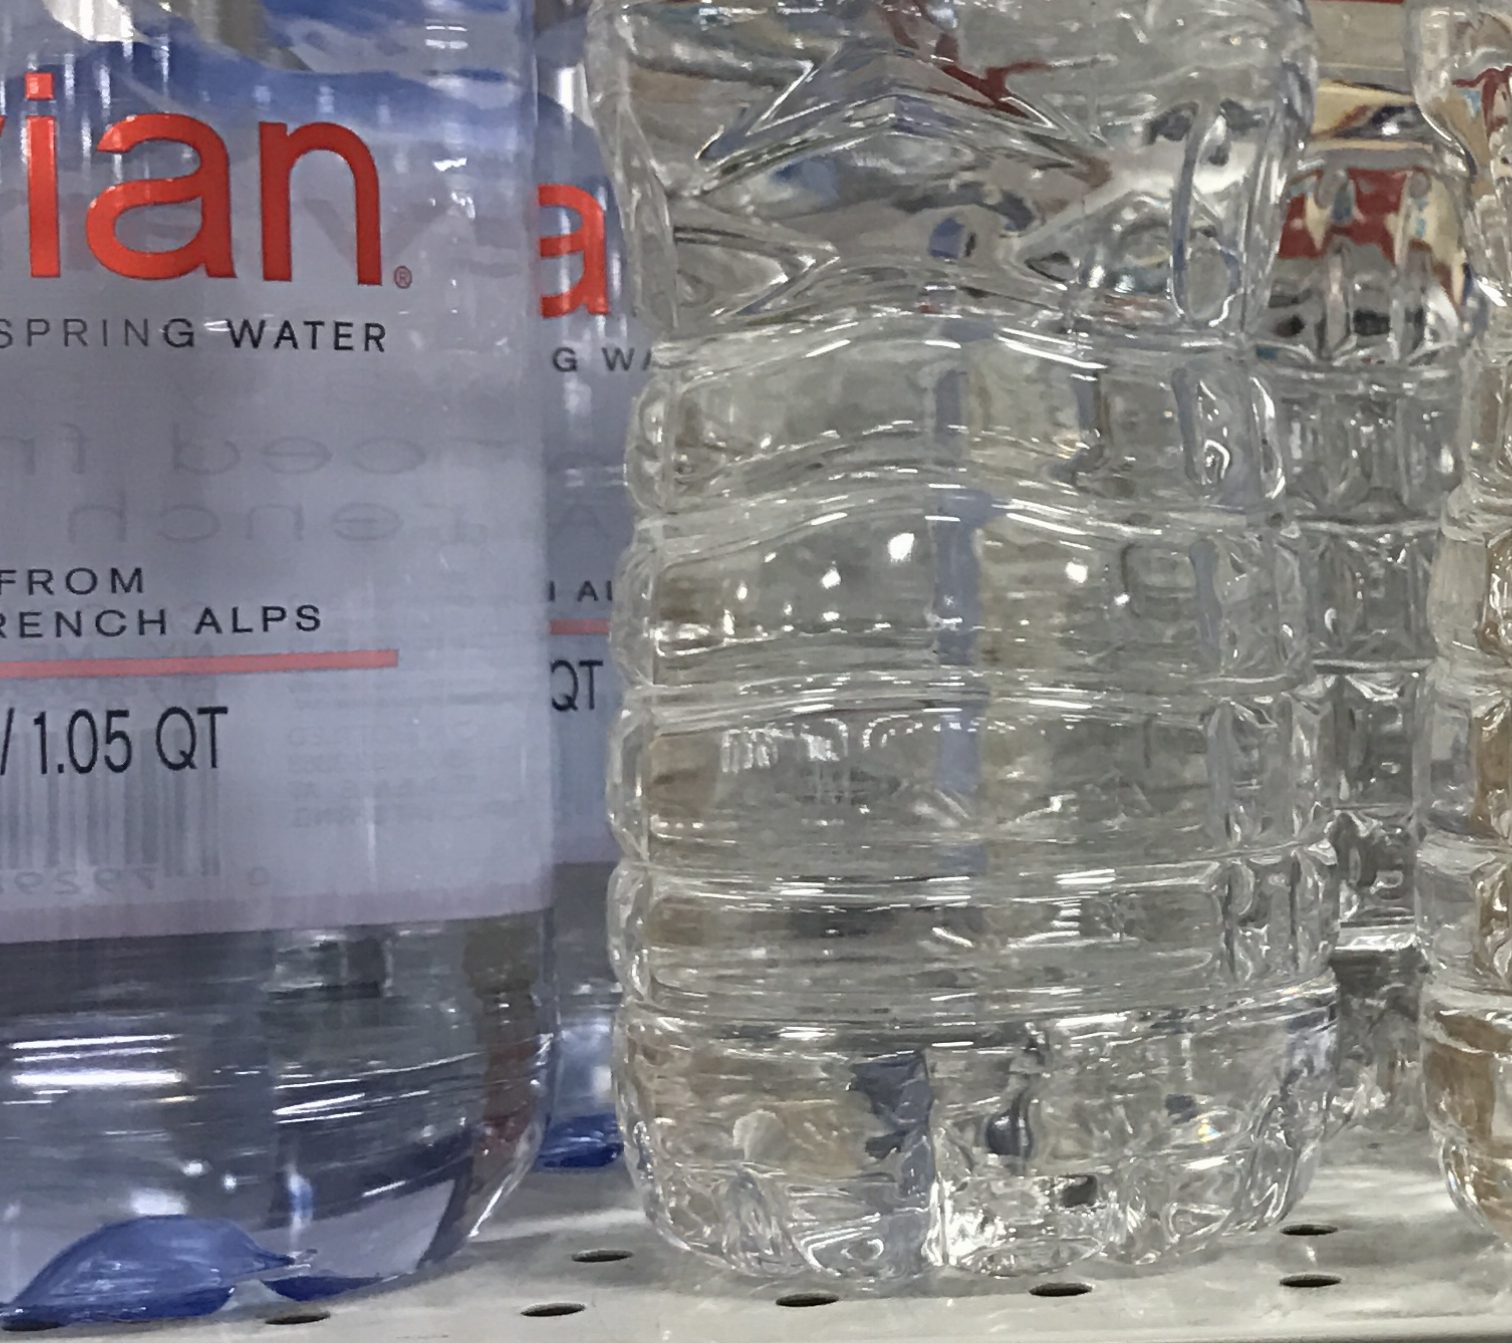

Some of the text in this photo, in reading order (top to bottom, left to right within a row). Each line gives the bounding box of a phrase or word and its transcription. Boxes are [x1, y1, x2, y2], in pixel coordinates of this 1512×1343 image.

[227, 316, 387, 353] WATER
[194, 604, 322, 636] ALPS
[33, 707, 133, 775] 1.05
[156, 706, 229, 770] QT
